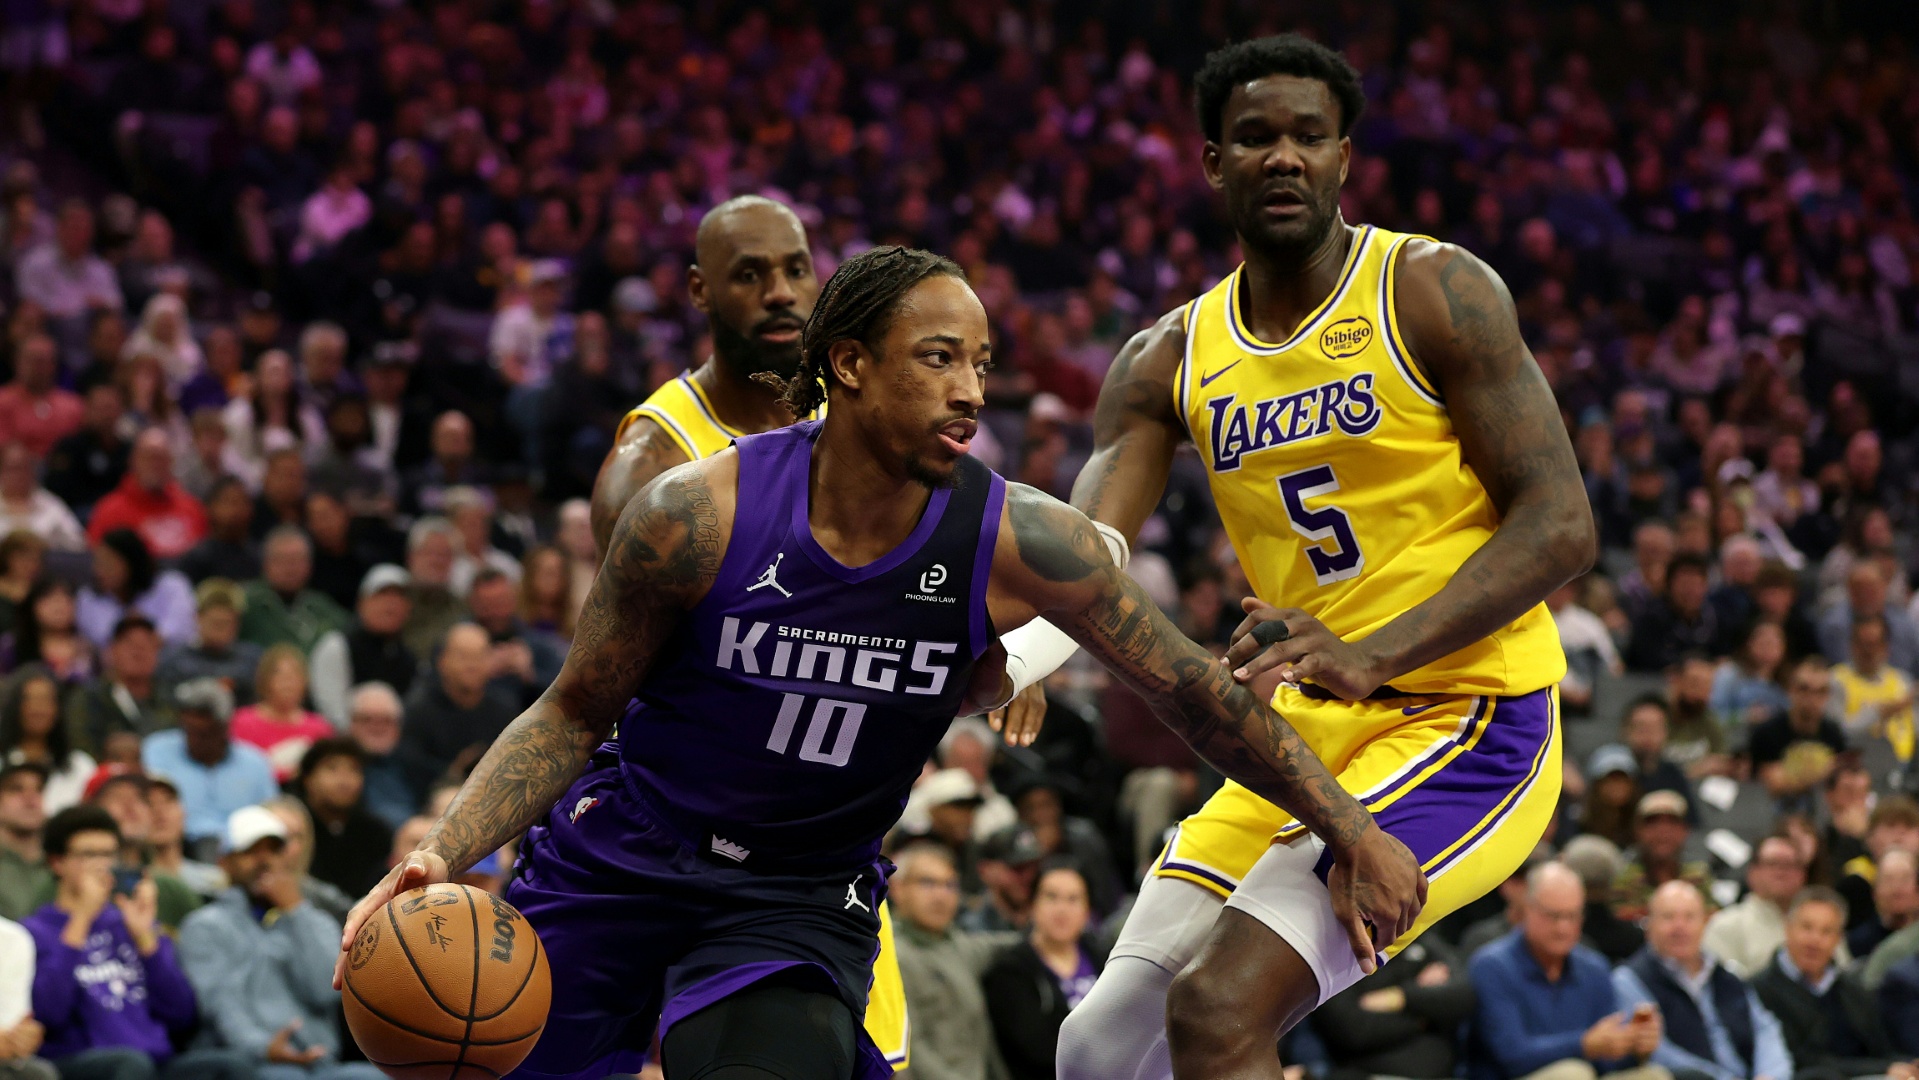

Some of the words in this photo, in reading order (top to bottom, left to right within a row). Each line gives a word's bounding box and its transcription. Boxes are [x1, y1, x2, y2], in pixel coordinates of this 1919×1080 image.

[1325, 327, 1370, 347] bibigo
[1206, 372, 1382, 473] LAKERS
[1275, 463, 1366, 587] 5
[905, 593, 938, 602] PHOONG
[938, 596, 956, 604] LAW
[777, 625, 906, 649] SACRAMENTO
[766, 692, 868, 767] 10
